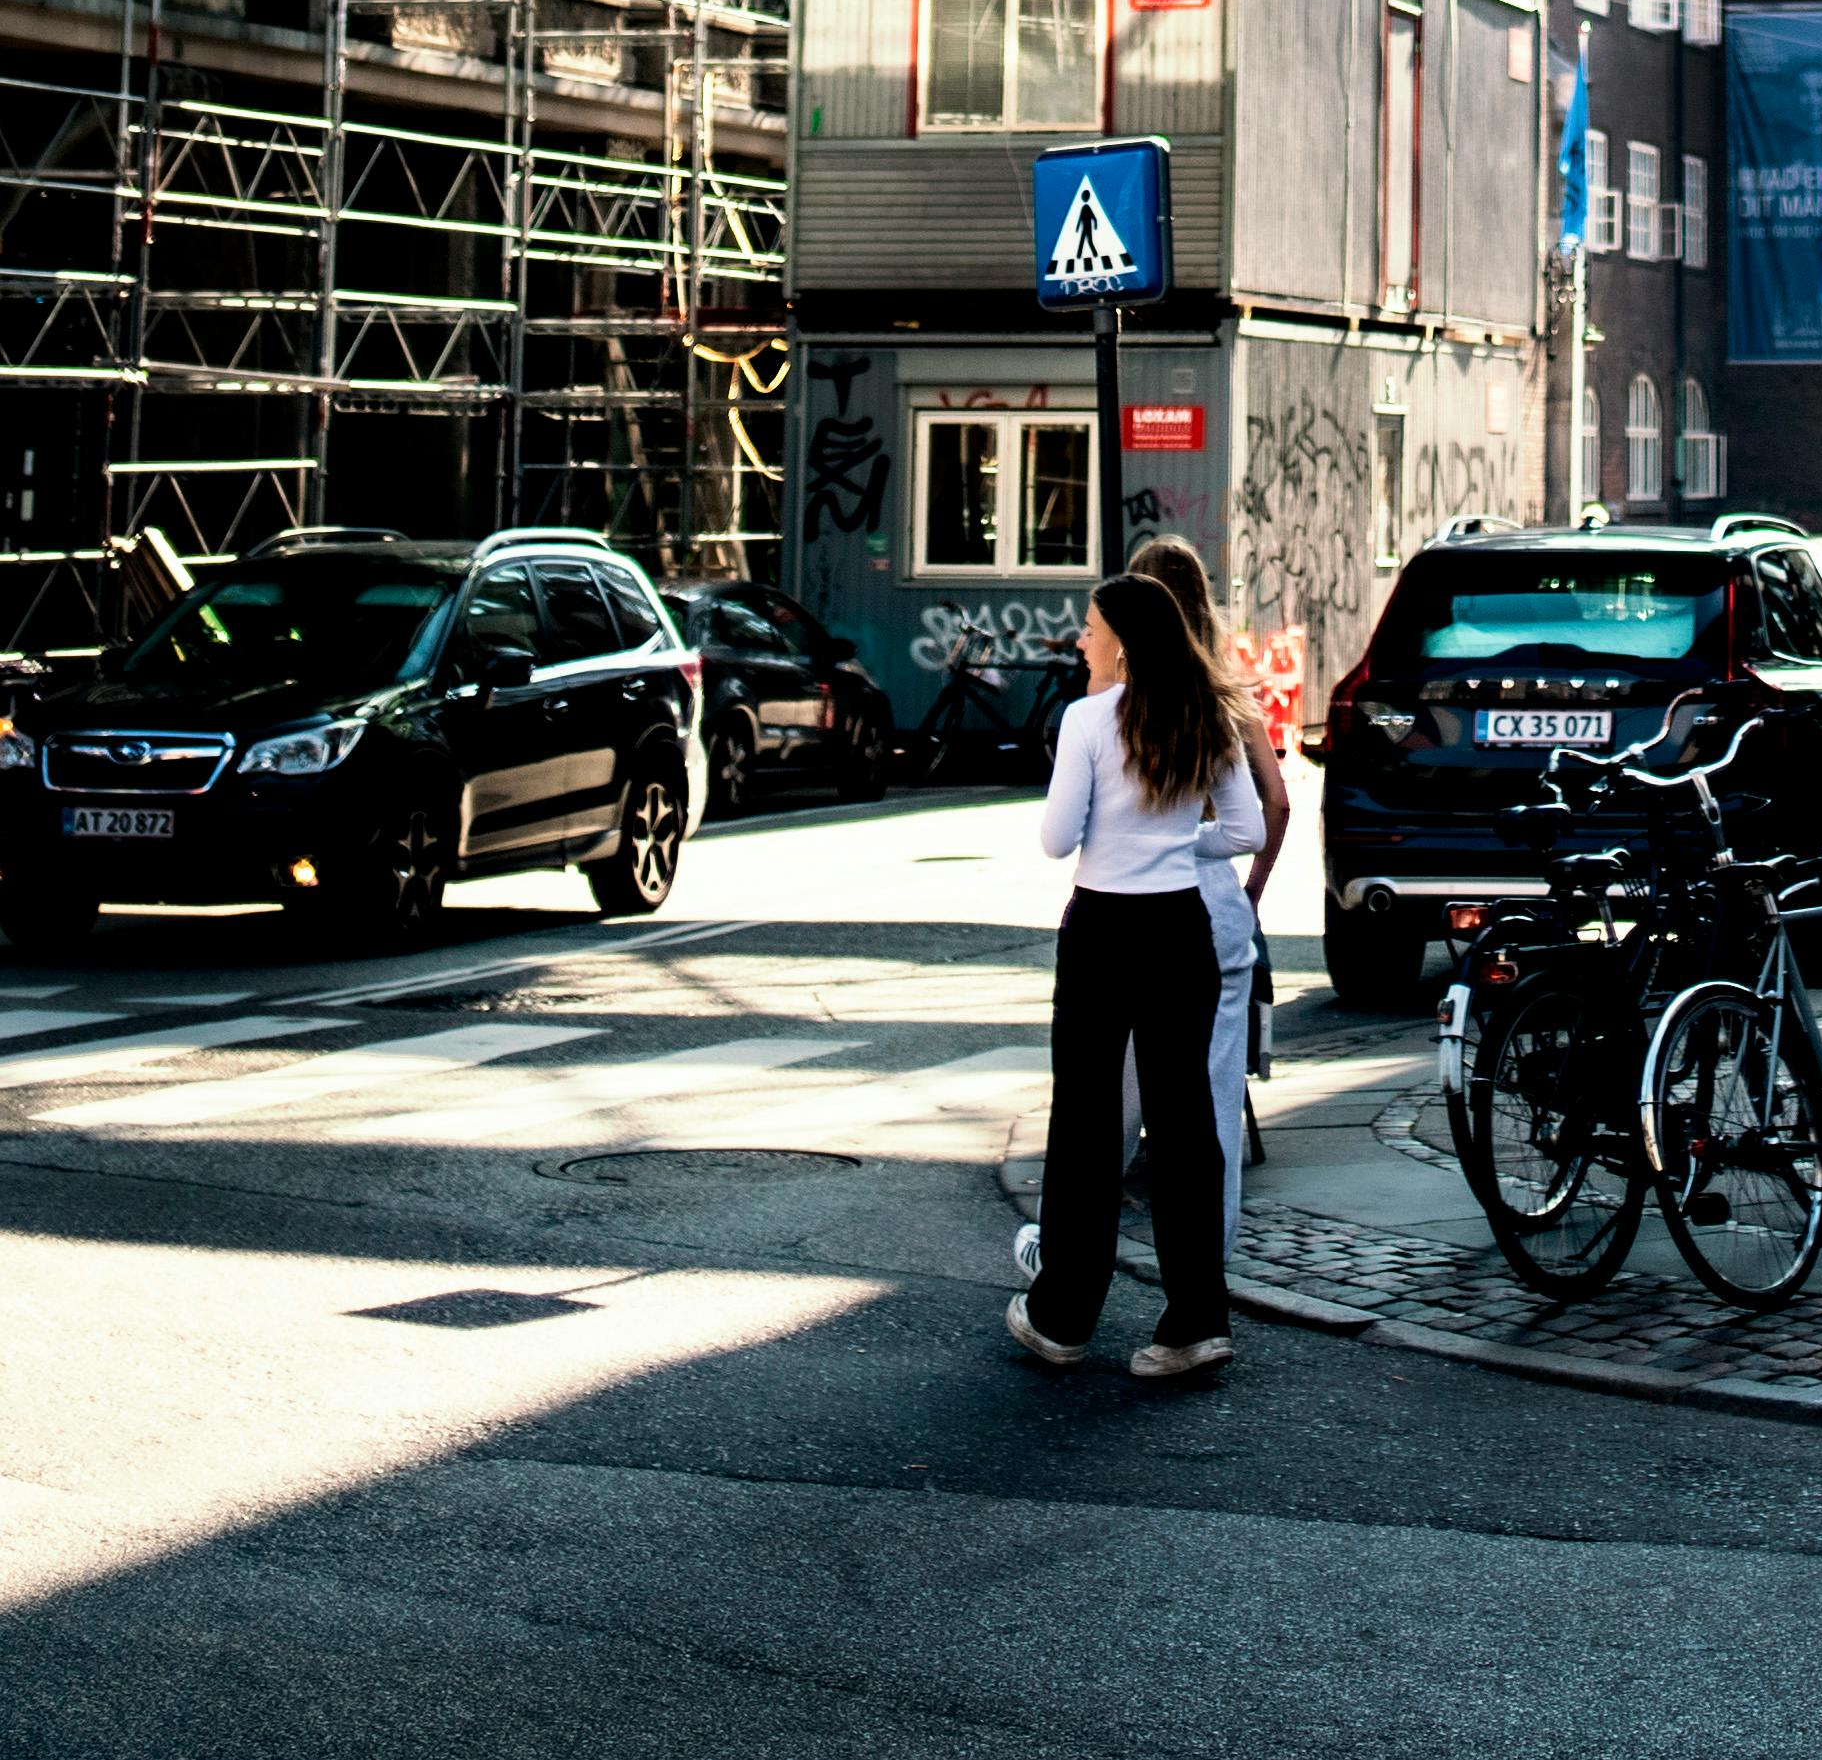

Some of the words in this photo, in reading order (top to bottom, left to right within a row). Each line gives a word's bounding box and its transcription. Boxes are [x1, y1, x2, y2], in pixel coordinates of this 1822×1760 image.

[1494, 715, 1523, 737] CX
[1530, 715, 1557, 737] 35
[1565, 715, 1604, 737] 071
[75, 812, 103, 832] AT
[106, 812, 131, 833] 20
[135, 812, 171, 834] 872
